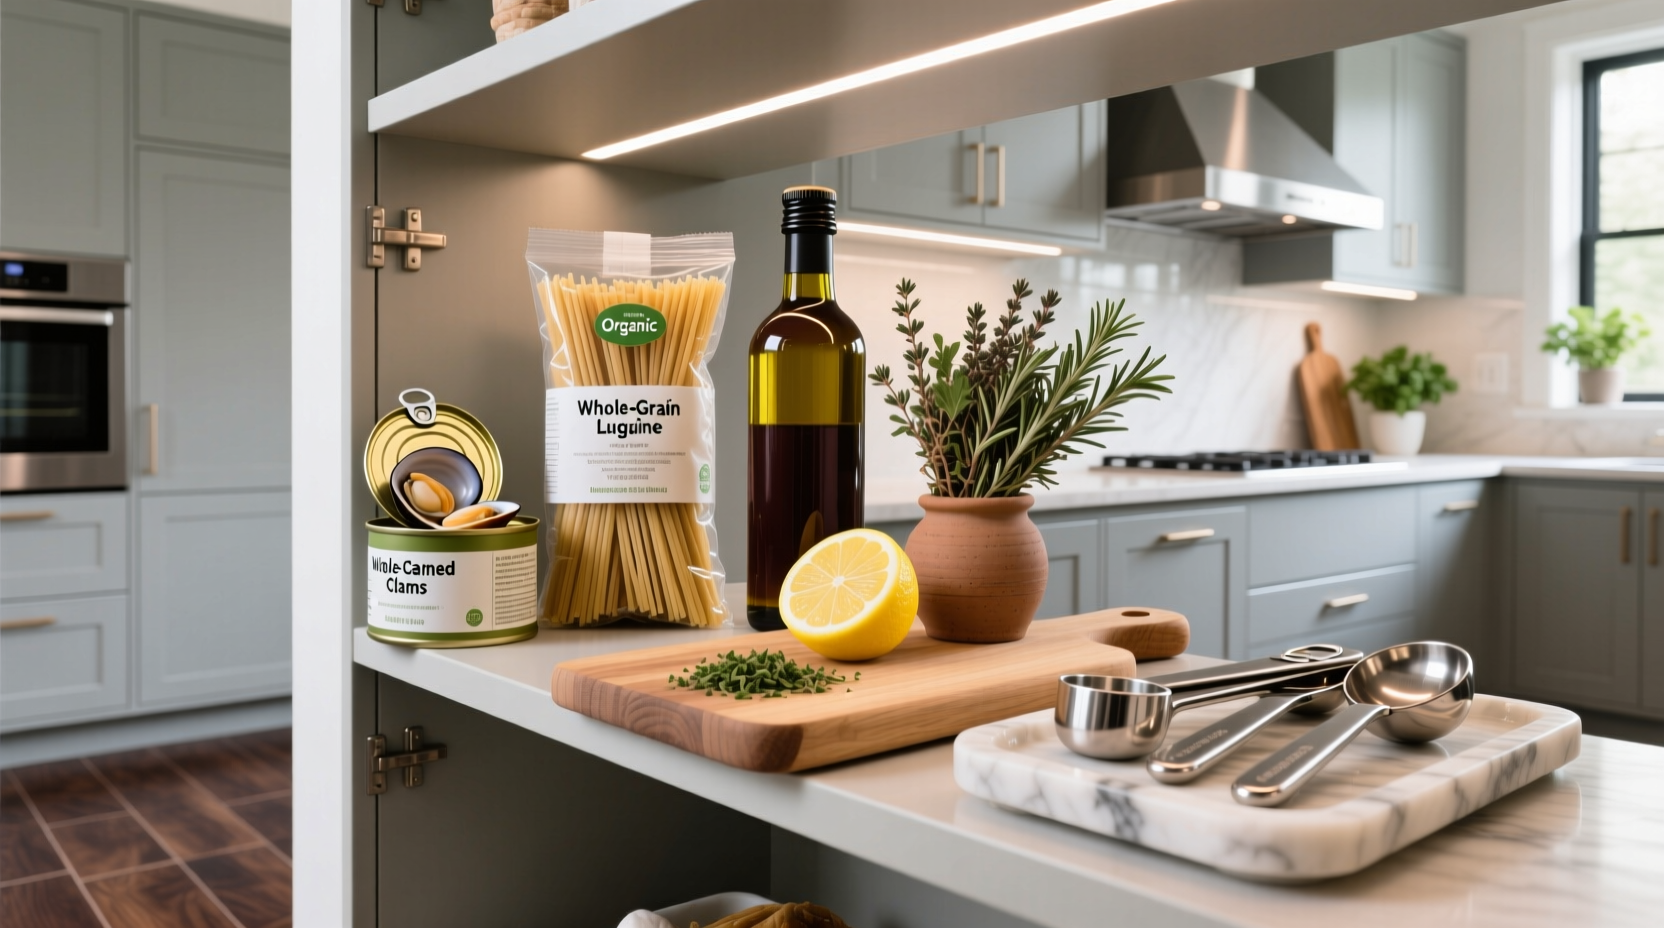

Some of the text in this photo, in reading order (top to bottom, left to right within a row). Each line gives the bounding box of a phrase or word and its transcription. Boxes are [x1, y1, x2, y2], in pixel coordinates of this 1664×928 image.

[601, 318, 658, 336] Organic
[577, 398, 681, 416] Whole-Grain
[386, 577, 428, 595] Clams
